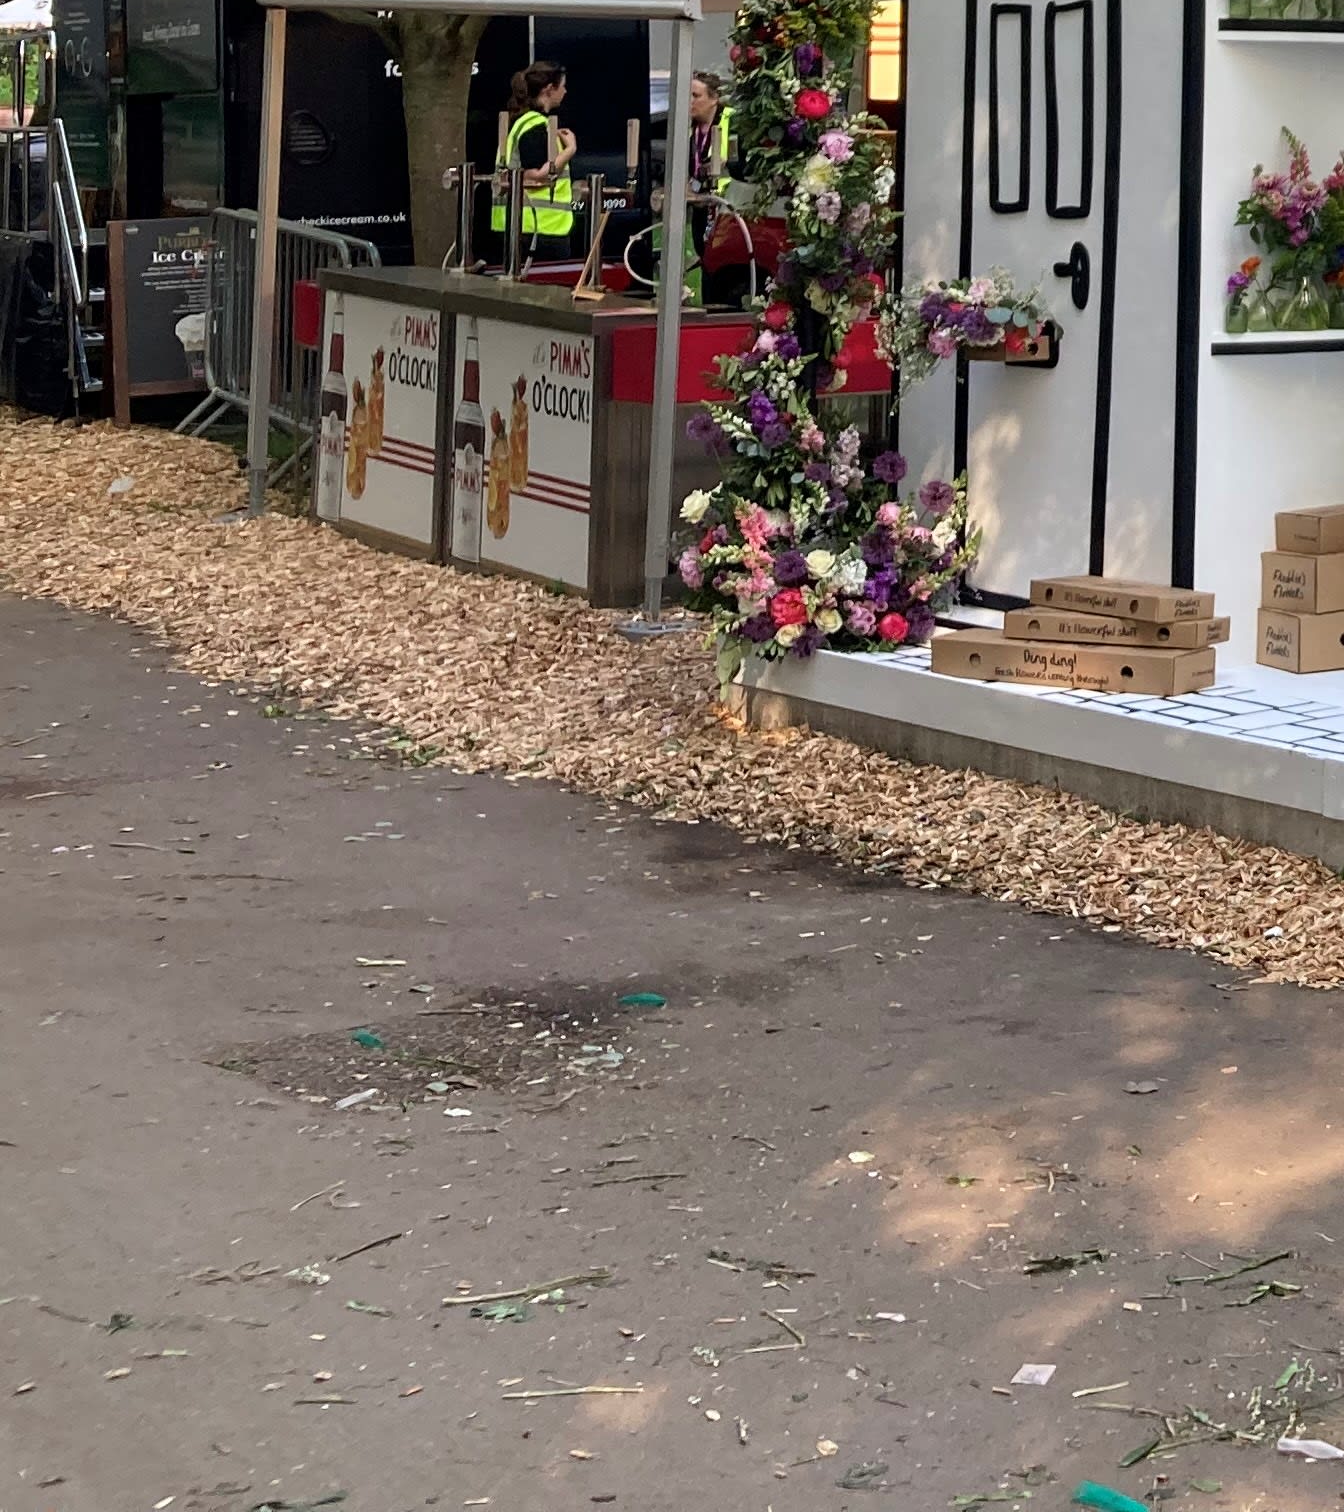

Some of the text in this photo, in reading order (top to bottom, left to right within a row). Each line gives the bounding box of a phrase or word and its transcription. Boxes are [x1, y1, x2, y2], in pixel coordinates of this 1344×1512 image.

[153, 251, 176, 263] Ice
[405, 314, 437, 351] PIMM'S
[389, 348, 436, 392] O'CLOCK!
[550, 340, 591, 379] PIMM'S
[533, 374, 590, 424] O'CLOCK!
[1024, 649, 1047, 672] Ding
